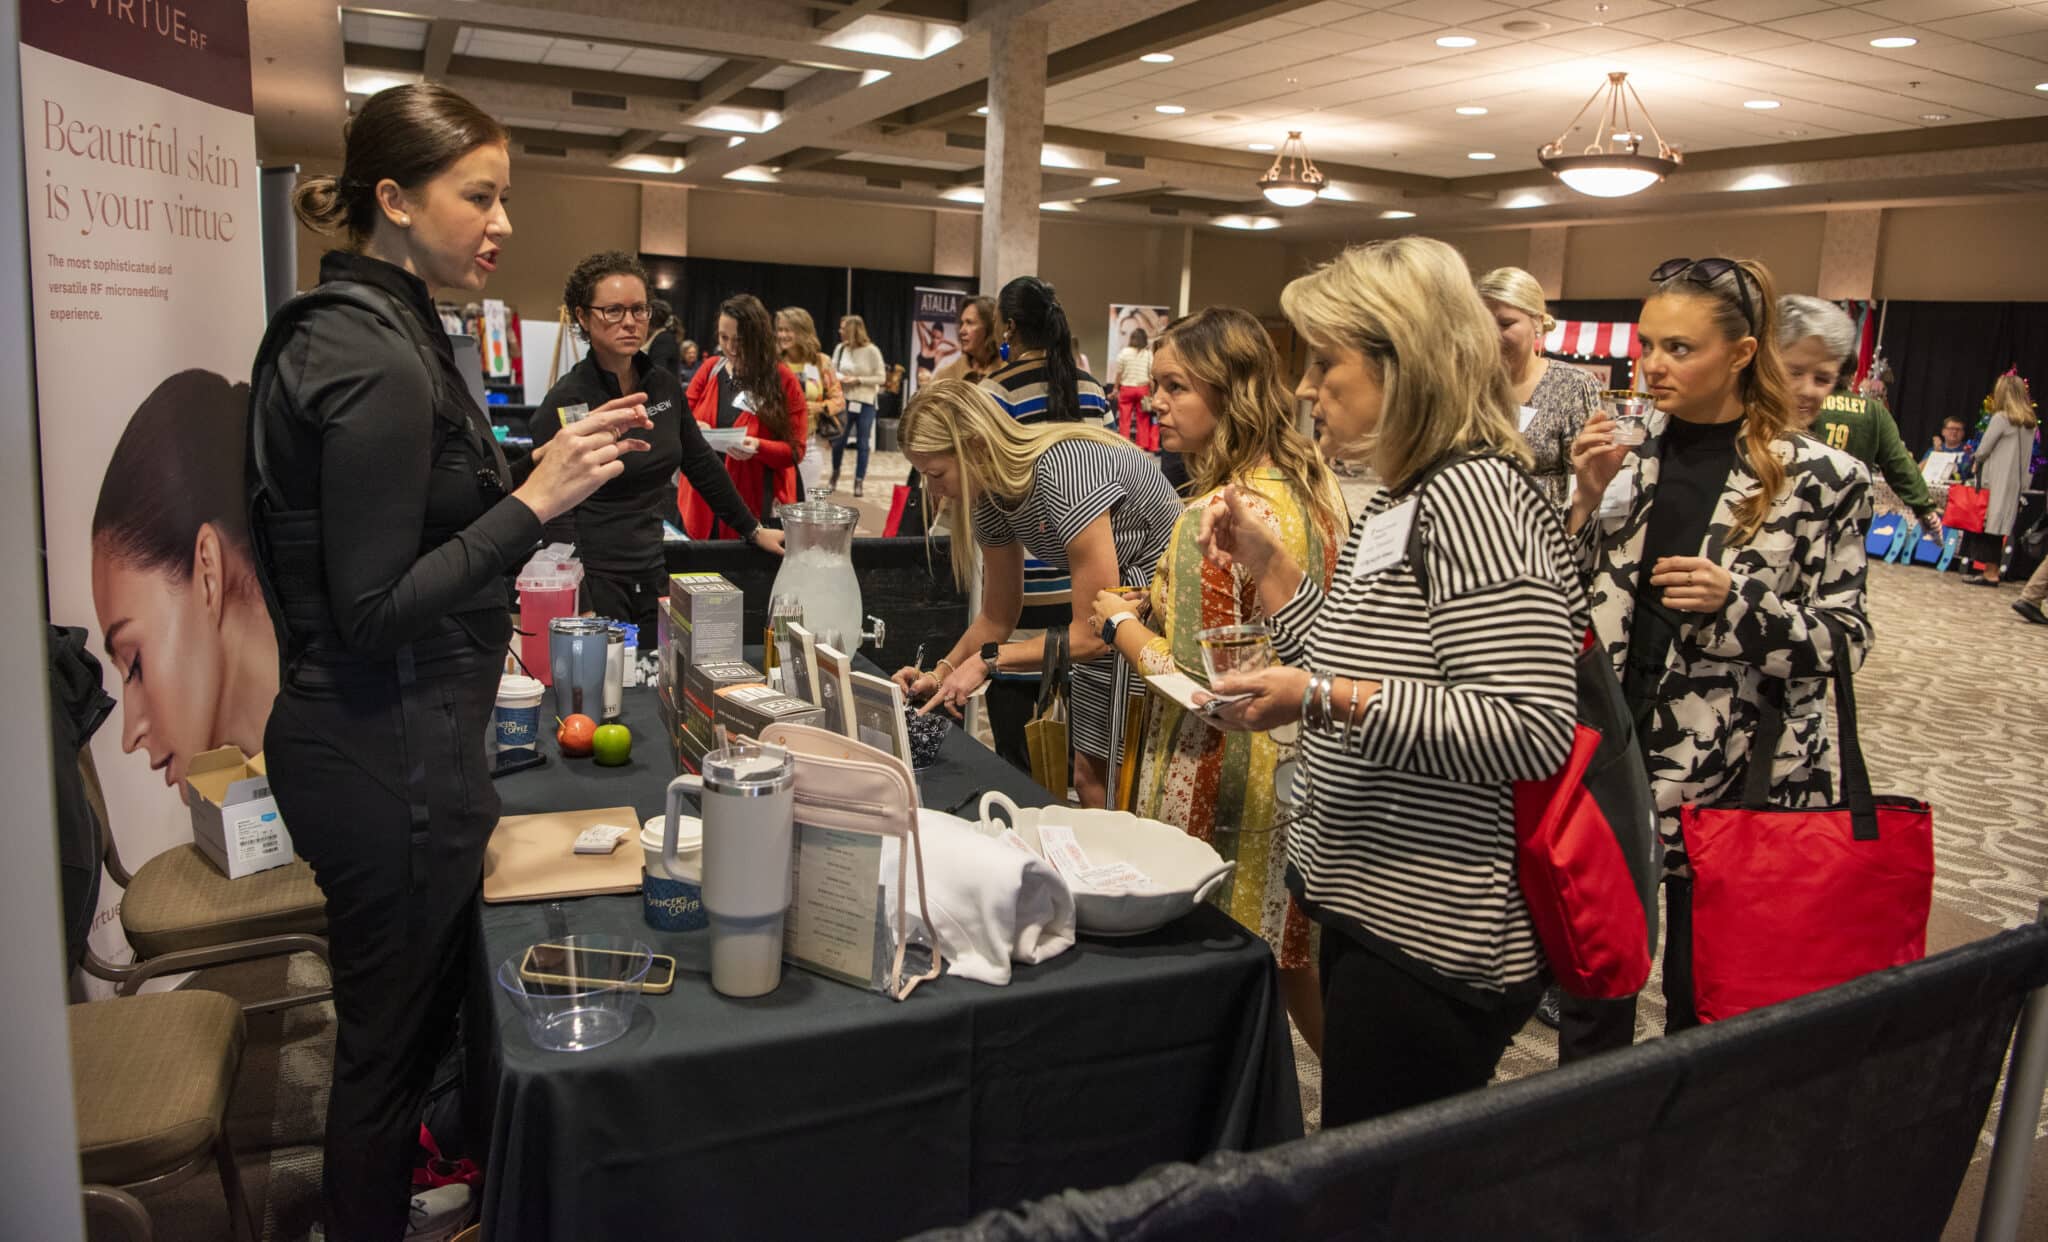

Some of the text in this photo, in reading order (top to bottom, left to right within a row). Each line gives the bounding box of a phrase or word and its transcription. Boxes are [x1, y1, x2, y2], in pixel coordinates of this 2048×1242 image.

[88, 0, 187, 44] RTUE
[43, 99, 239, 188] Beautiful skin
[44, 169, 234, 242] is your virtue
[48, 254, 173, 275] The most sophisticated and
[48, 282, 168, 301] versatile RF microneedling
[921, 294, 957, 313] ATALLA
[50, 307, 103, 322] experience.
[648, 399, 673, 417] ENEW
[1825, 422, 1849, 451] 79
